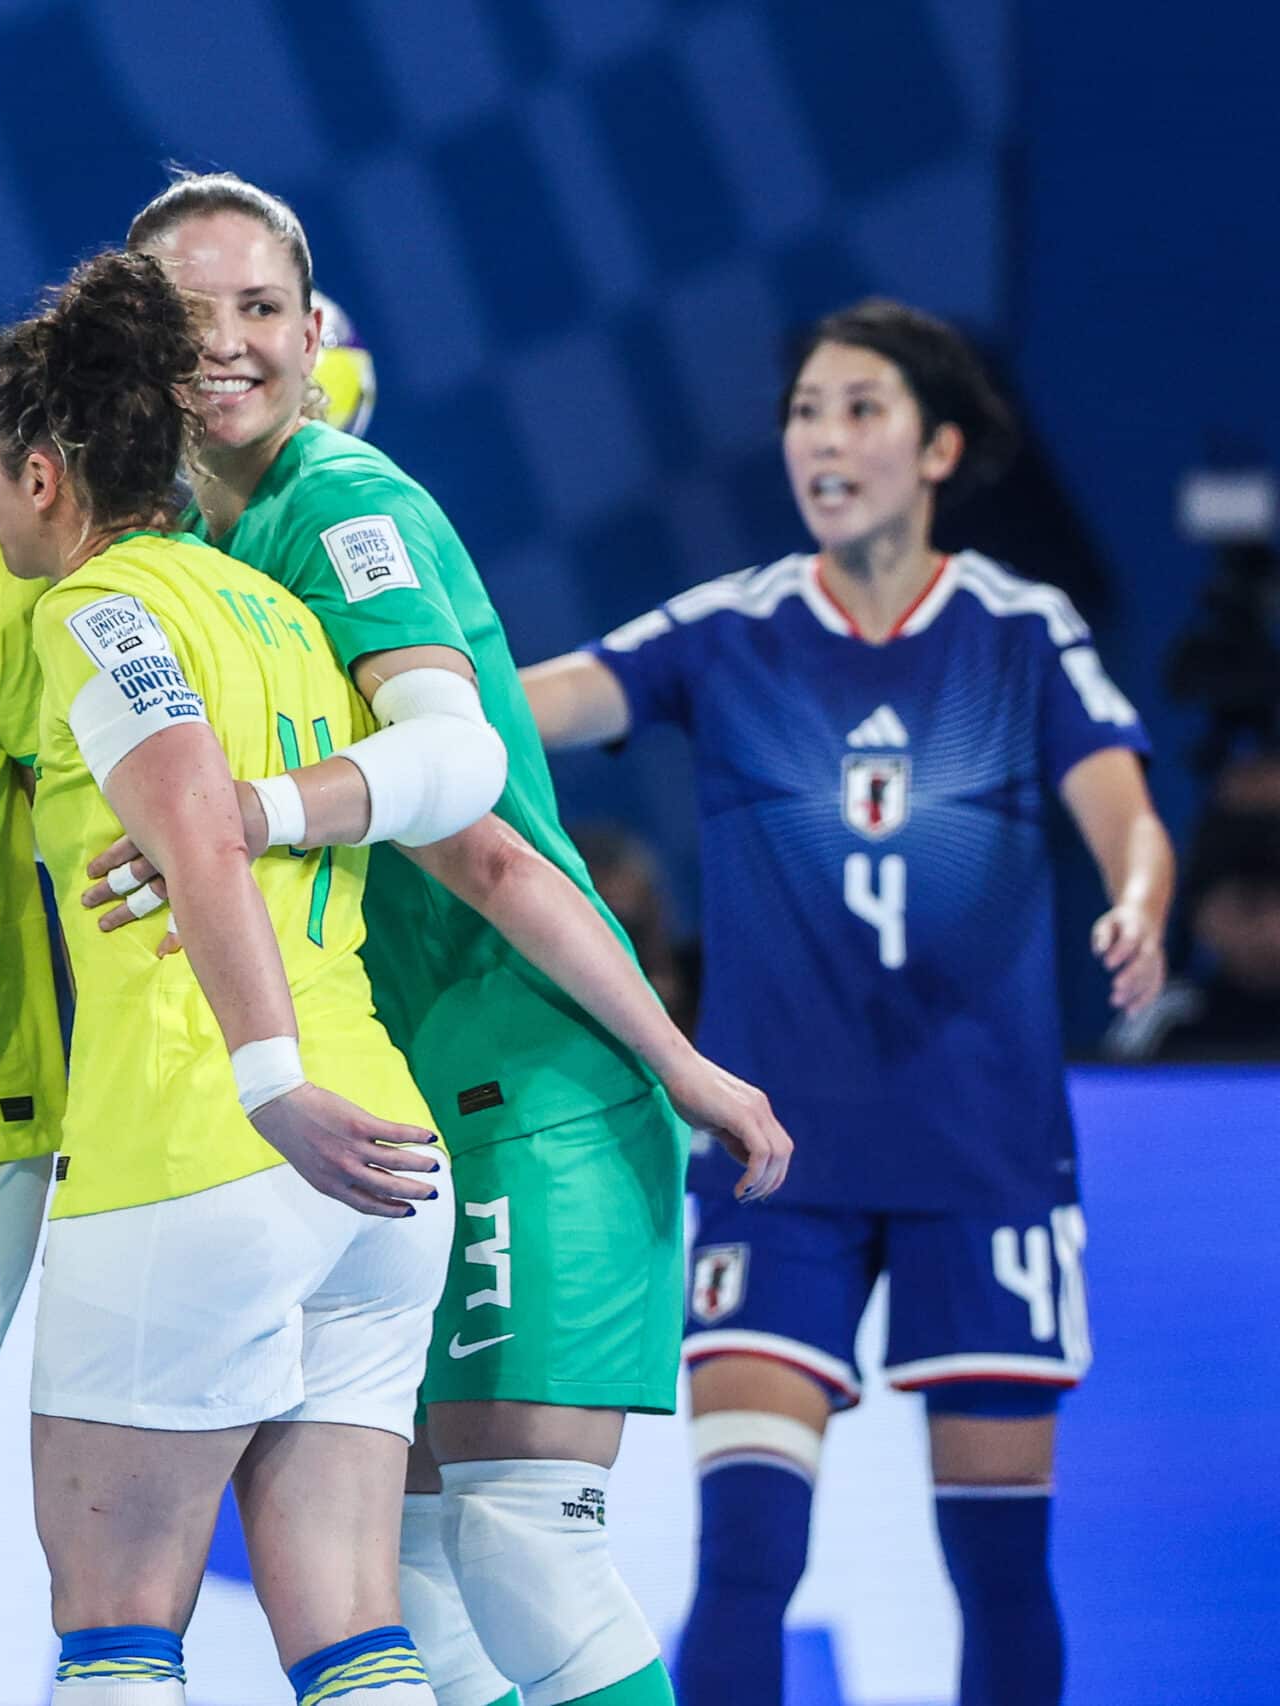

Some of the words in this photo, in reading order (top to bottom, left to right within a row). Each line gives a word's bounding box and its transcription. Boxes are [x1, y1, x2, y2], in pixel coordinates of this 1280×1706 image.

[346, 538, 389, 560] UNITES
[86, 607, 122, 627] FOOTB
[91, 610, 136, 638] UNITES
[111, 656, 176, 683] FOOTBA
[120, 669, 187, 699] UNITE
[129, 697, 163, 715] the
[843, 852, 907, 970] 4
[464, 1195, 511, 1311] 3
[991, 1226, 1057, 1342] 4
